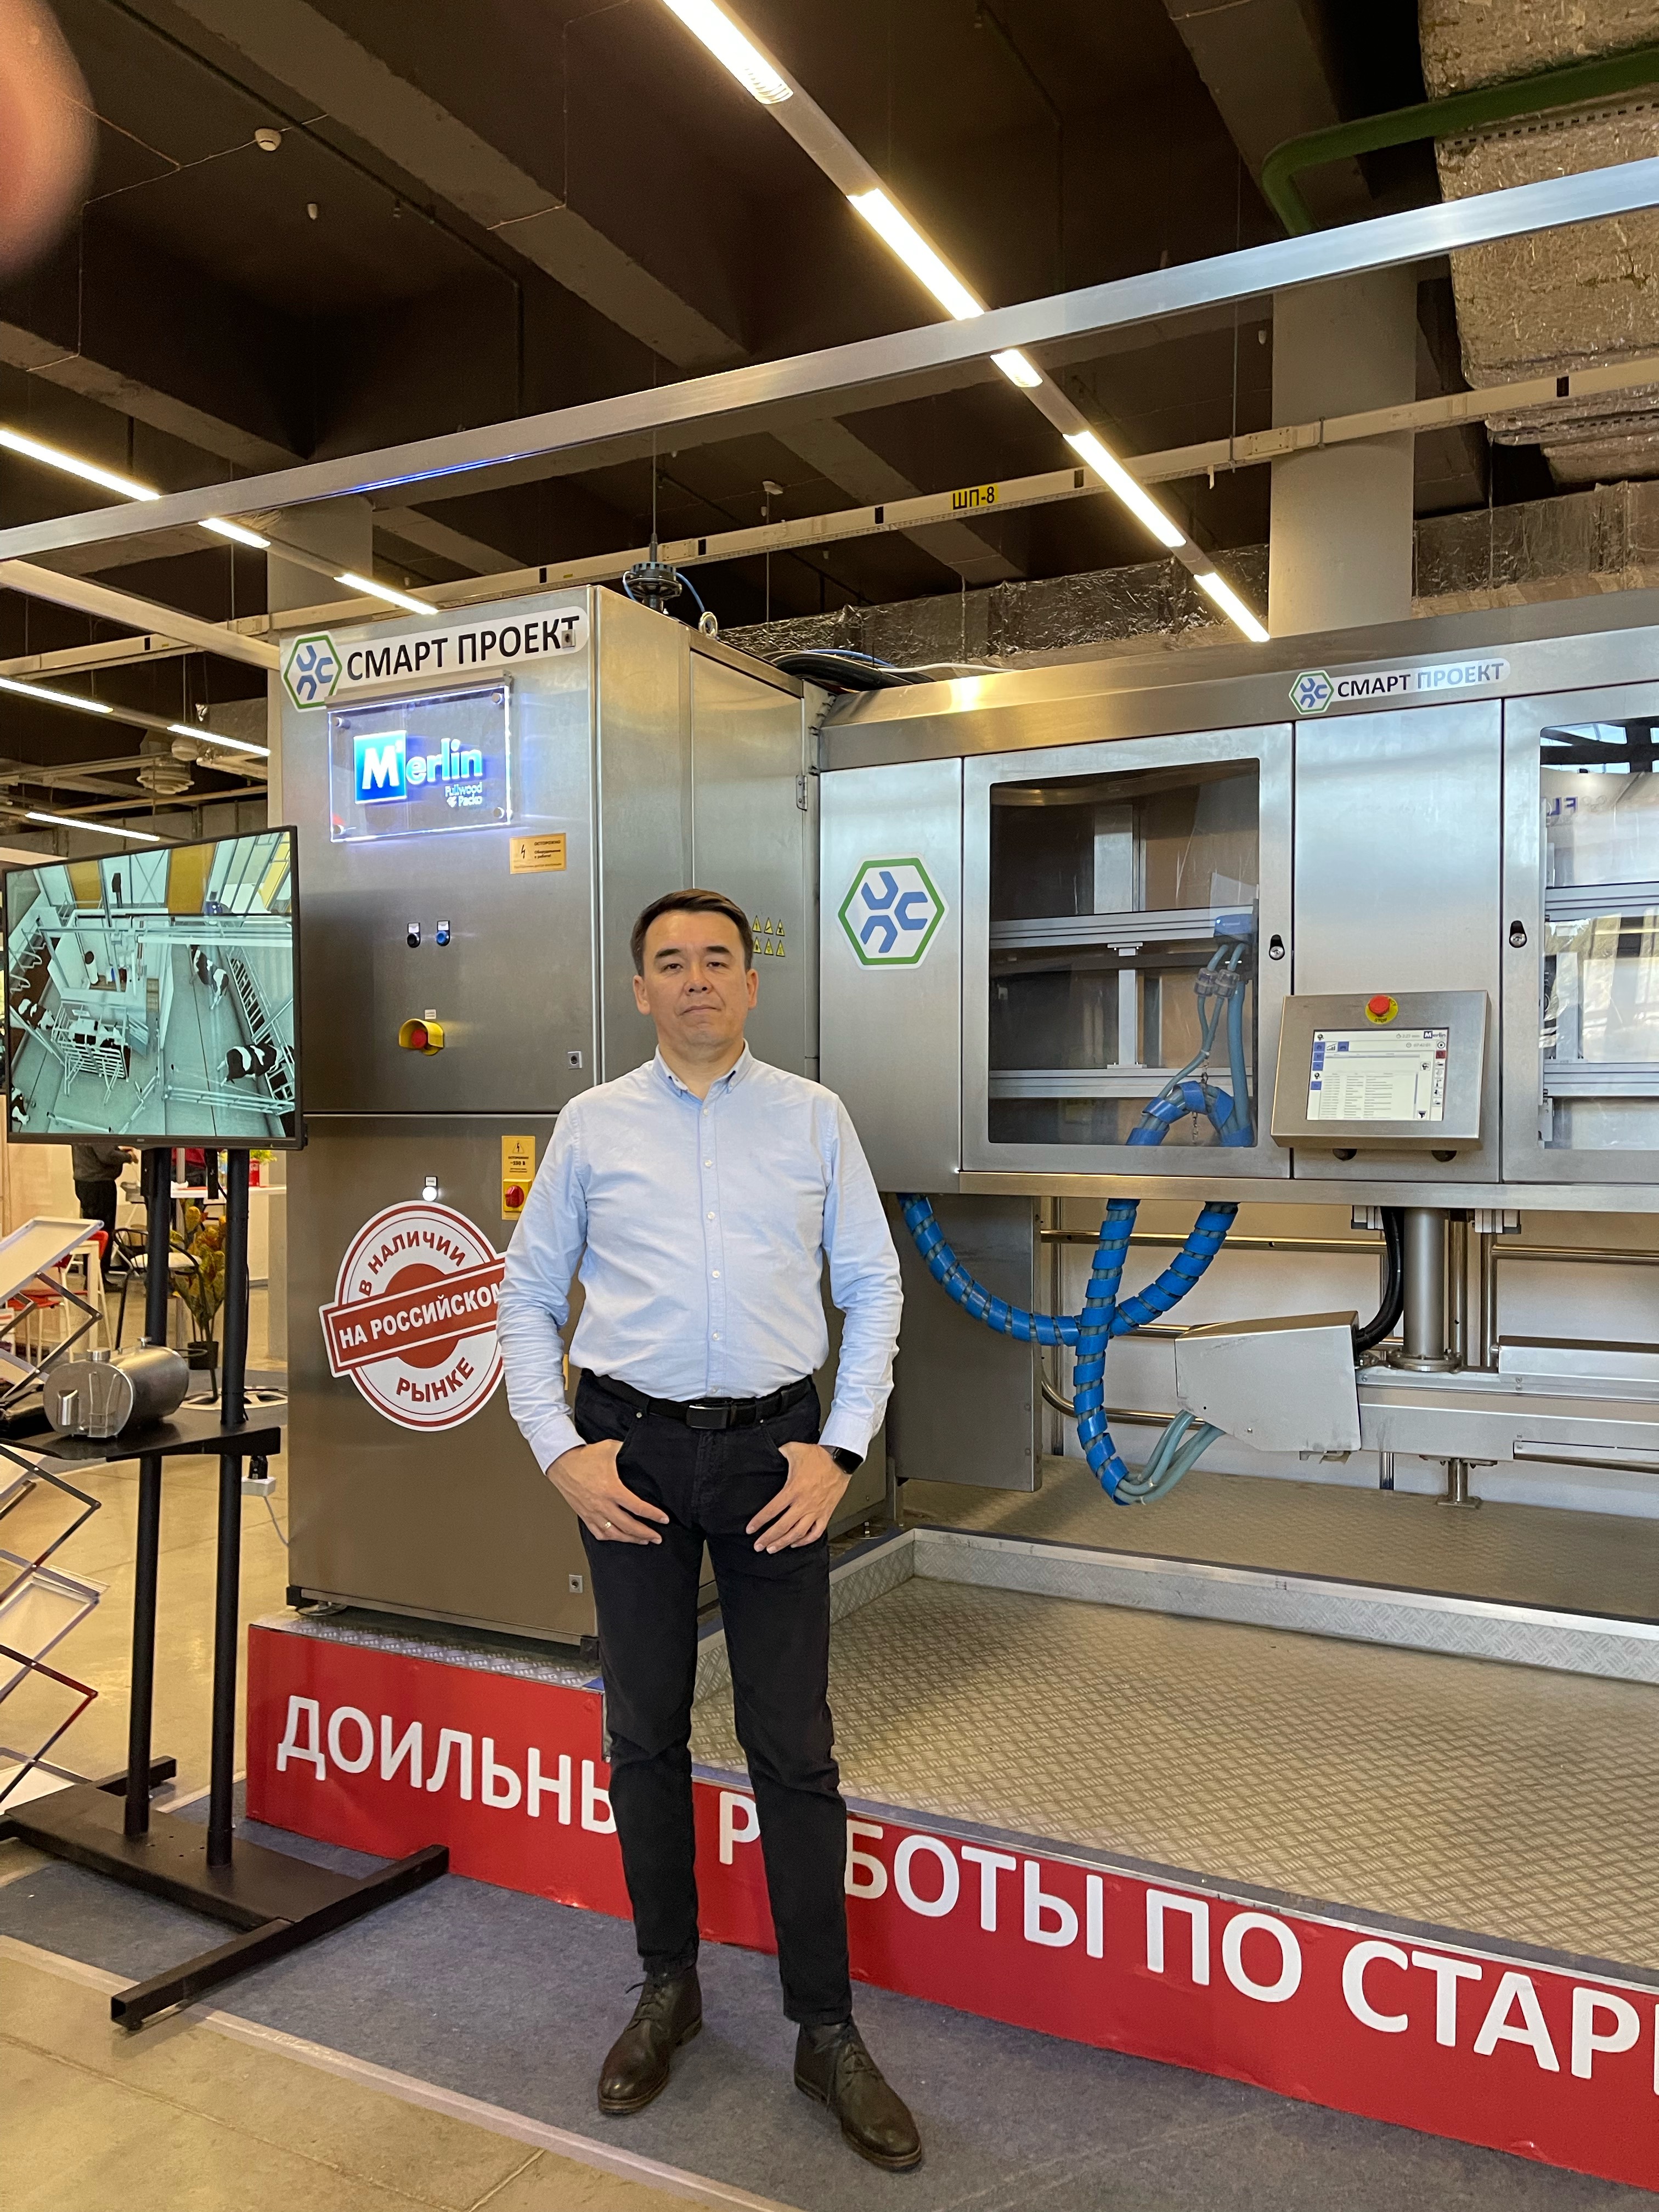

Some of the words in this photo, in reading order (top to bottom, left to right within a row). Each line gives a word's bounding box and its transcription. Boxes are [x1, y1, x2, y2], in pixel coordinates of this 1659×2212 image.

[952, 486, 995, 510] ШП-8
[347, 637, 448, 681] СМАРТ
[458, 616, 580, 664] ПРОЕКТ
[1337, 674, 1411, 698] СМАРТ
[1417, 663, 1504, 690] ПРОЕКТ
[362, 737, 483, 789] Merlin
[358, 1279, 373, 1296] В
[368, 1231, 466, 1276] НАЛИЧИИ
[338, 1325, 368, 1350] НА
[395, 1357, 475, 1403] РЫНКЕ
[719, 1791, 1104, 1959] РБОТЫ
[1146, 1888, 1303, 2003] ПО
[1342, 1940, 1659, 2096] СТАР
